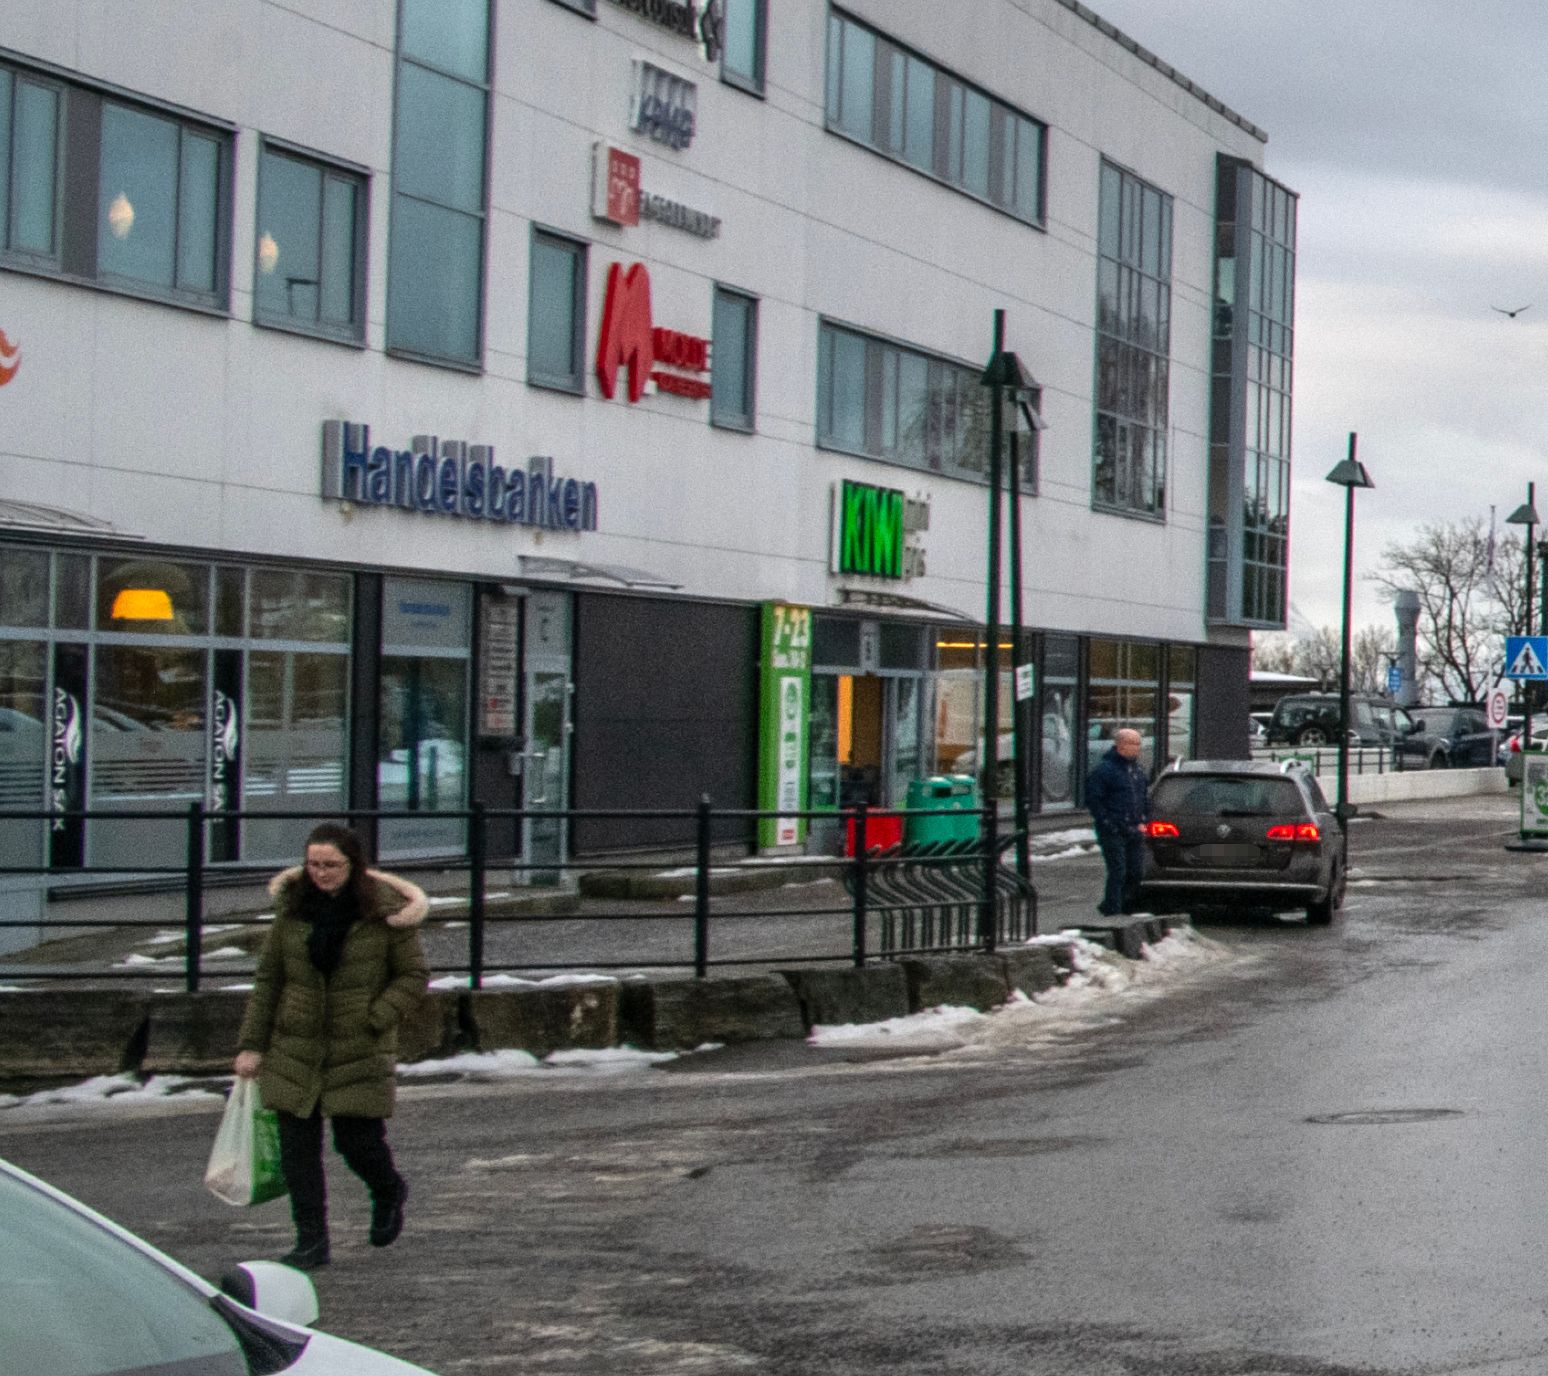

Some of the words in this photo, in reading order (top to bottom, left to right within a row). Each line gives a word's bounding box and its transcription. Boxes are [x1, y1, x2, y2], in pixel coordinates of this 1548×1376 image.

[326, 420, 598, 531] Handelsbanken
[842, 481, 904, 578] KIWI
[53, 687, 67, 784] AGATON
[213, 689, 227, 780] AGATON
